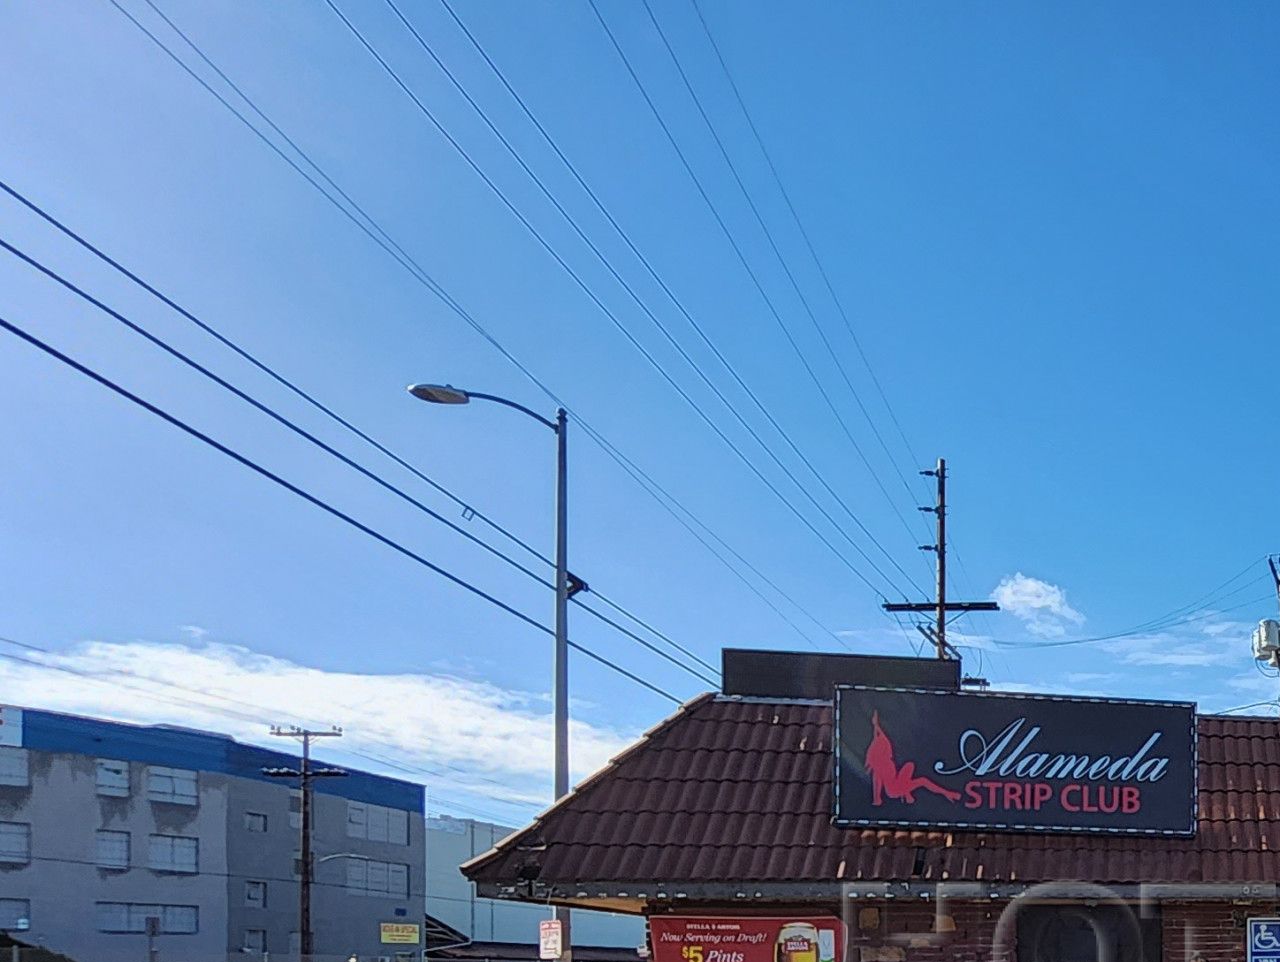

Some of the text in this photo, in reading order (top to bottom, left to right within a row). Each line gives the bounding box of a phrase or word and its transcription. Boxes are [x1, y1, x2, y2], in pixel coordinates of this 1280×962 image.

[934, 717, 1169, 782] Alameda
[964, 781, 1142, 814] STRIP CLUB
[660, 932, 683, 941] Now
[684, 932, 720, 944] Serving
[736, 932, 767, 944] Draft!
